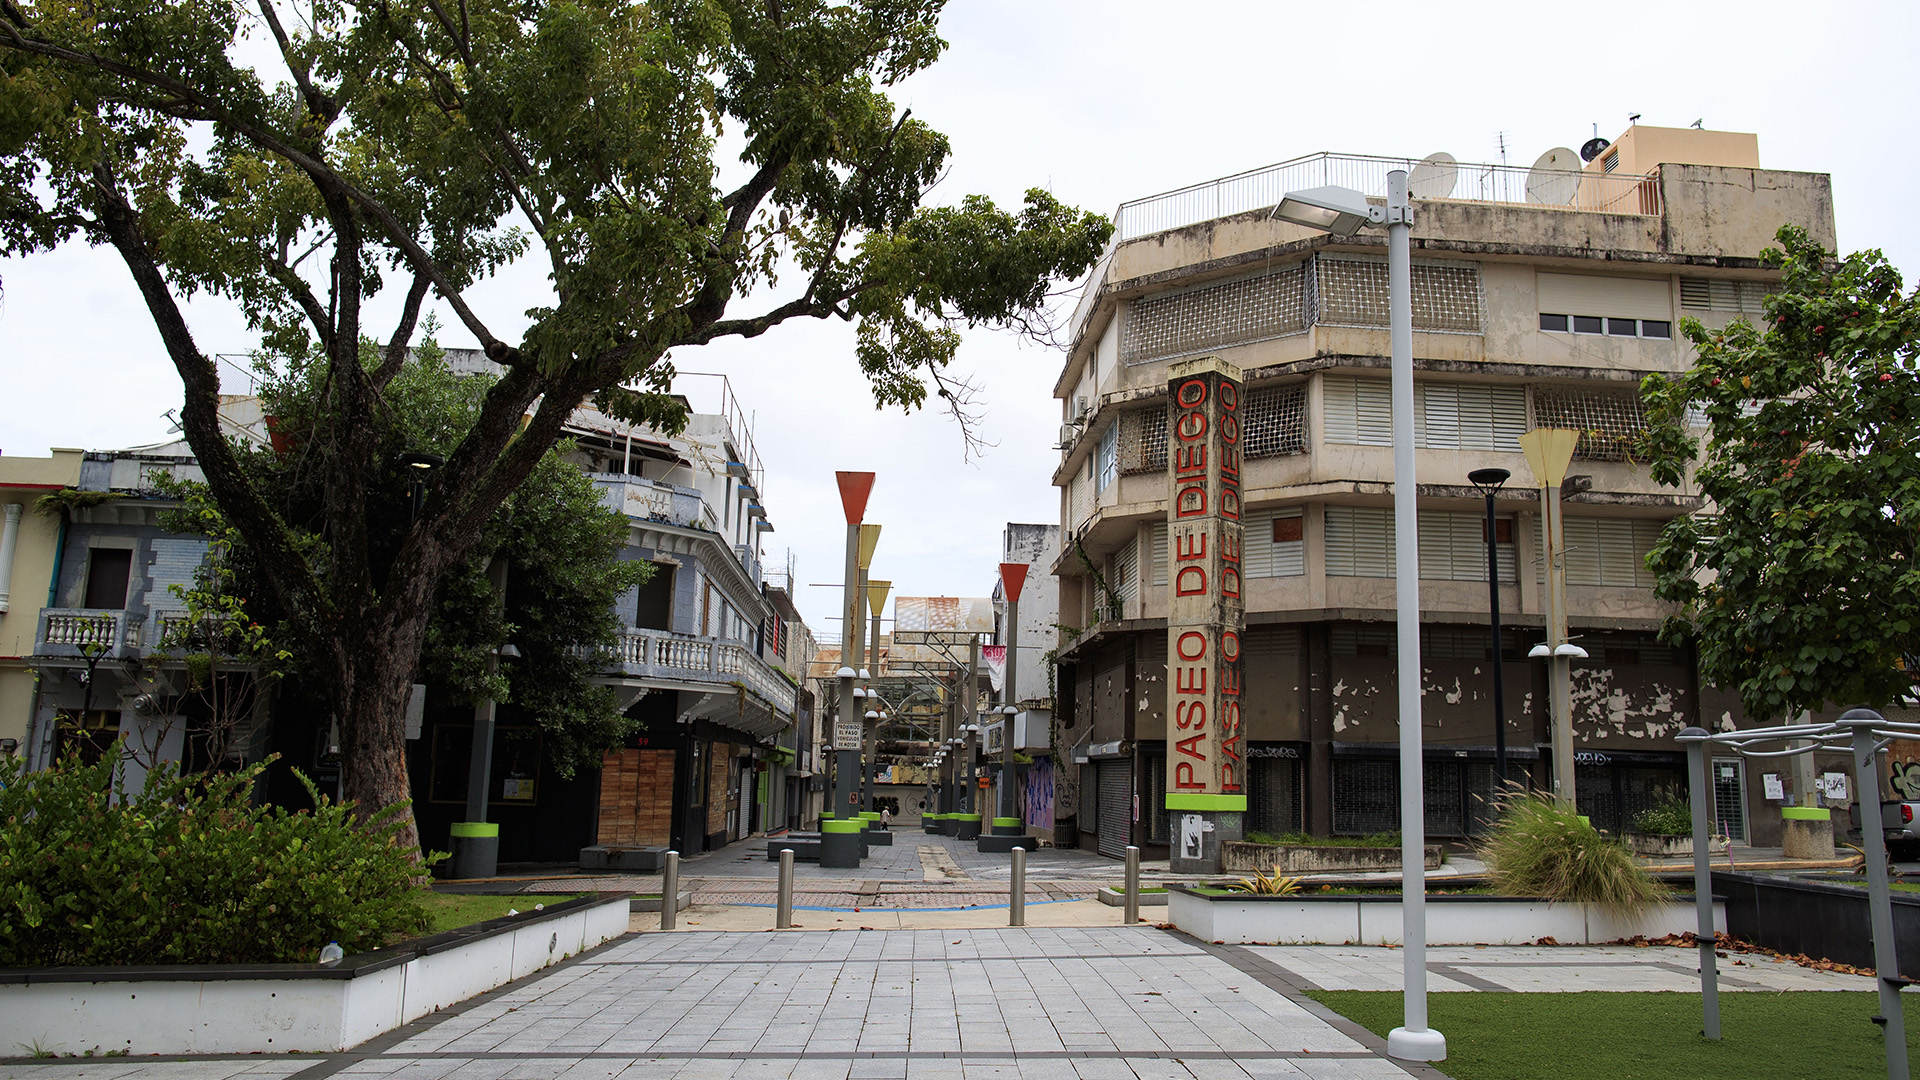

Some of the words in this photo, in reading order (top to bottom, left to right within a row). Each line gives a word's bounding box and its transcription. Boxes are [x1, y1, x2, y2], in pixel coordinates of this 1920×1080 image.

[1176, 379, 1207, 518] DIEGO
[1220, 381, 1239, 520] DIEGO
[1176, 532, 1207, 598] DE
[1221, 533, 1240, 599] DE
[637, 737, 649, 746] 59
[1176, 631, 1207, 790] PASEO
[1221, 631, 1240, 791] PASEO
